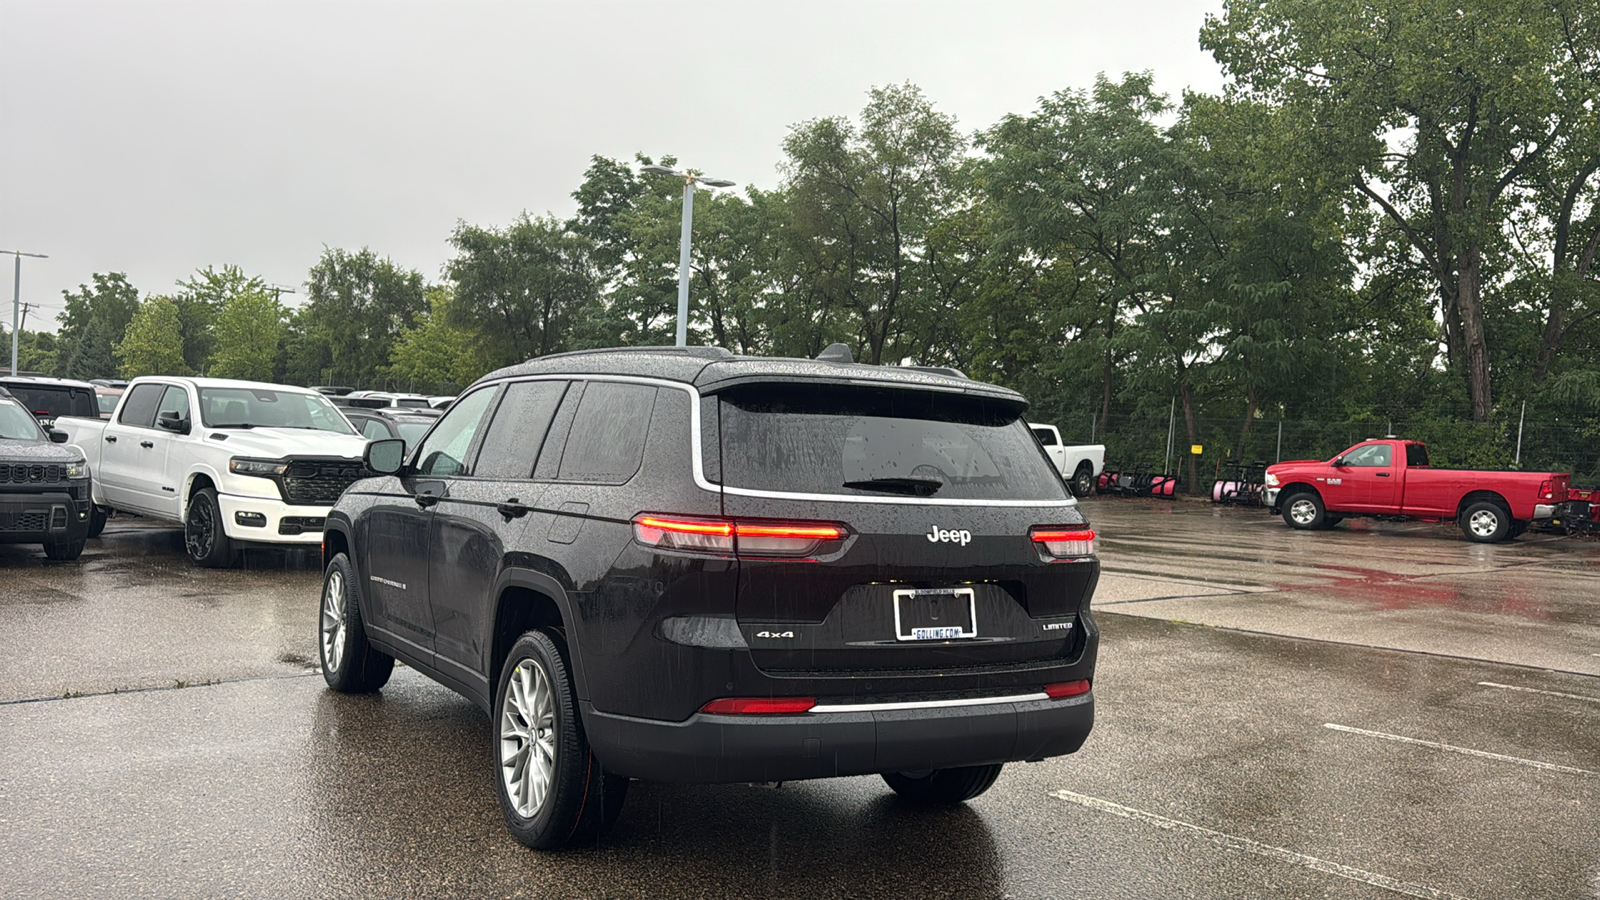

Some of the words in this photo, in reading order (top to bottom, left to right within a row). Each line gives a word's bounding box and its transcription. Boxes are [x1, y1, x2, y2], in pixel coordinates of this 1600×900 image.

[926, 525, 972, 547] Jeep
[1042, 622, 1072, 630] LIMITED
[916, 628, 959, 640] GOLLING.COM
